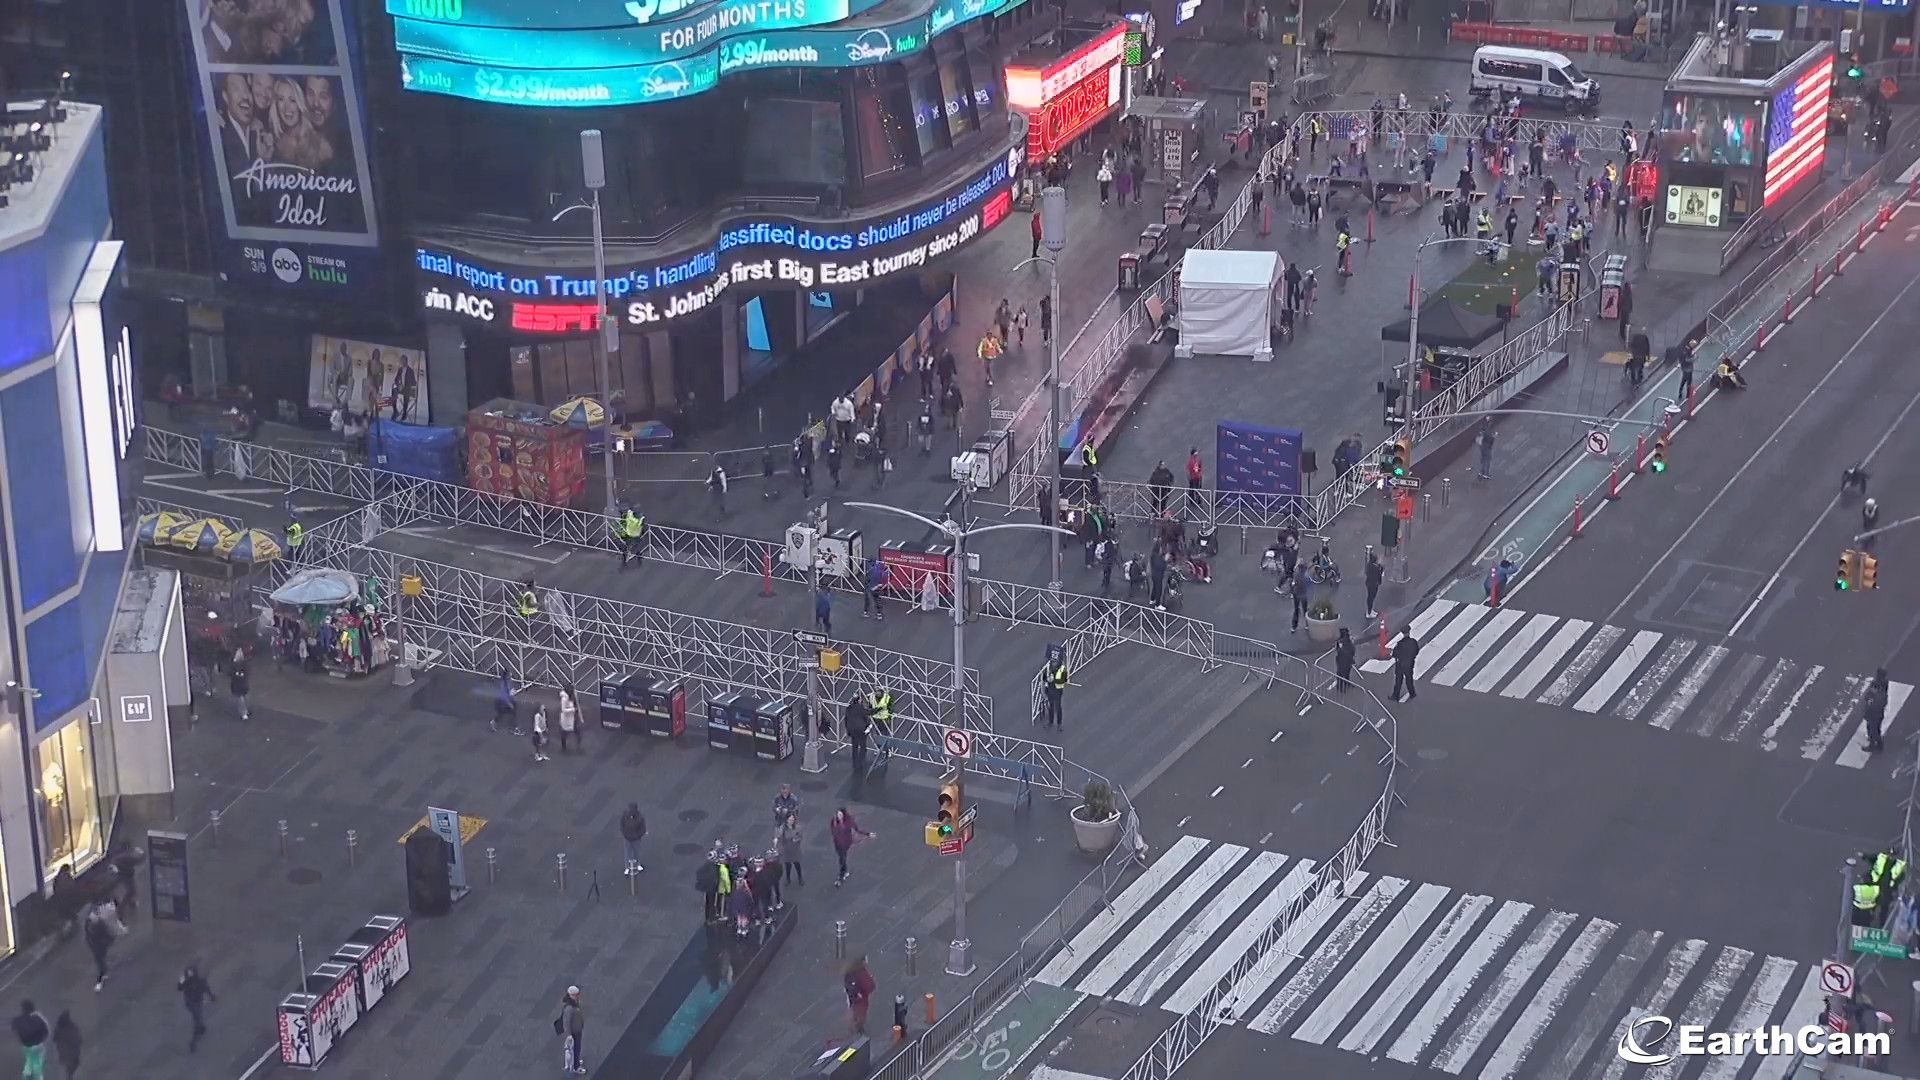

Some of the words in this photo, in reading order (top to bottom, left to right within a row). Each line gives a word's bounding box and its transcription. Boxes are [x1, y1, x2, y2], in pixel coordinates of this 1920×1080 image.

[660, 27, 694, 51] FOR
[697, 16, 718, 42] FOUR
[719, 1, 806, 28] MONTHS
[233, 158, 357, 199] American
[275, 193, 328, 226] Idol
[244, 247, 266, 261] SUN
[307, 255, 334, 266] STREAM
[335, 259, 347, 268] ON
[455, 262, 506, 291] report
[510, 278, 540, 296] on
[655, 250, 716, 288] handling
[798, 229, 853, 251] docs
[858, 213, 911, 248] should
[912, 202, 946, 231] never
[945, 196, 957, 216] be
[250, 260, 268, 274] 3/9
[274, 258, 301, 272] abc
[308, 264, 348, 284] hulu
[628, 301, 661, 325] St.
[664, 283, 715, 320] John's
[730, 259, 774, 284] first
[778, 257, 814, 288] Big
[820, 259, 870, 285] East
[872, 243, 929, 278] tourney
[928, 230, 959, 258] since
[958, 213, 979, 244] 2000
[454, 291, 495, 322] ACC
[363, 923, 406, 974] CHICAGO
[311, 970, 356, 1025] CHICAGO
[279, 1011, 293, 1063] CHICAGO
